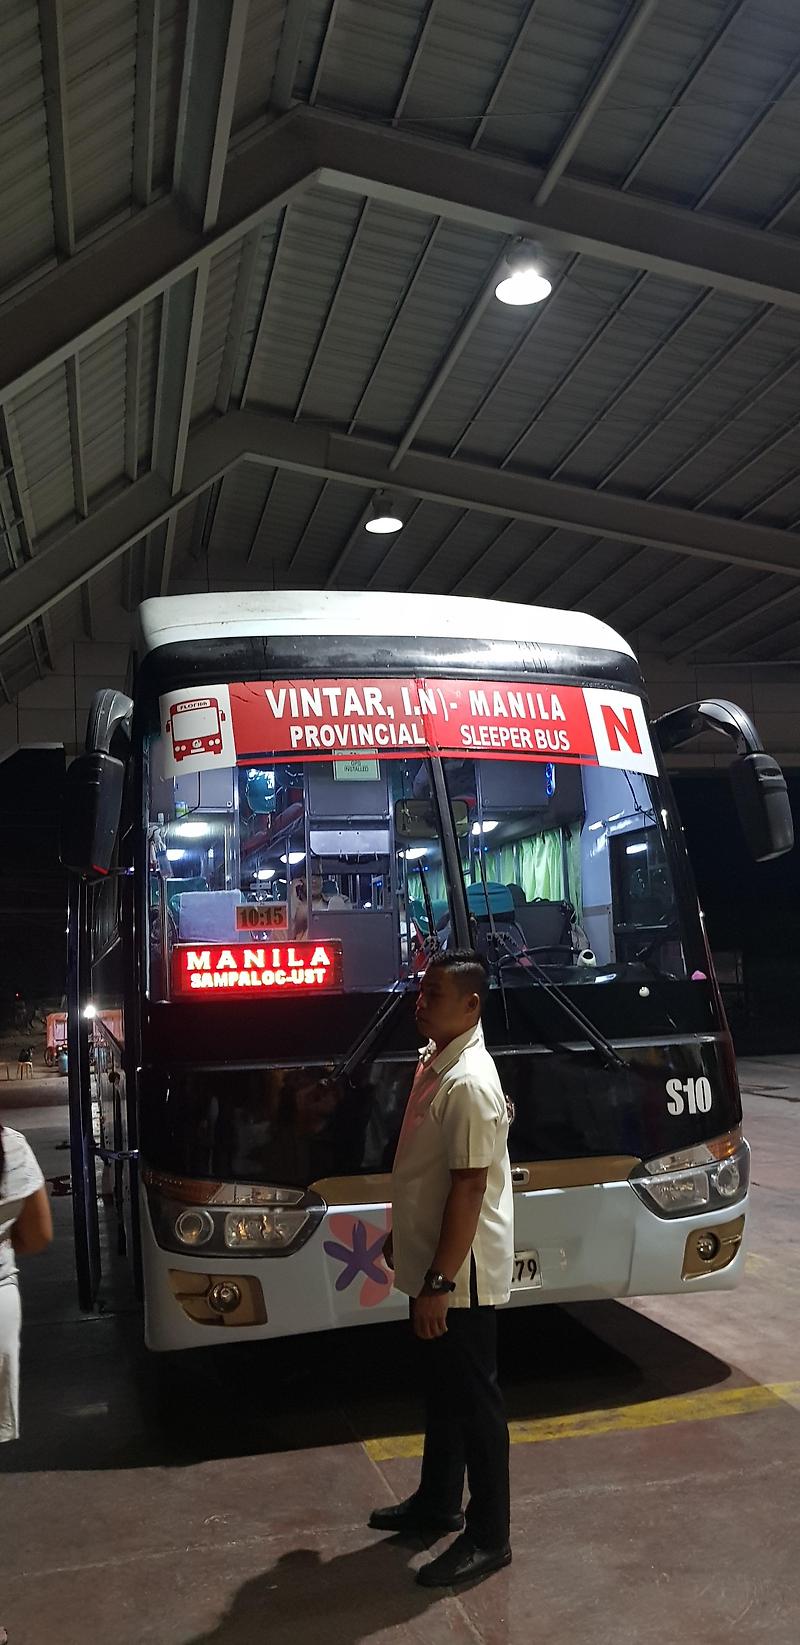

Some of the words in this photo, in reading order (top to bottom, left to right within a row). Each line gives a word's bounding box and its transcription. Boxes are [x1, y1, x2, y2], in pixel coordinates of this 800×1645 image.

[265, 687, 393, 720] VINTAR,
[469, 689, 566, 721] MANILA
[290, 723, 426, 748] PROVINCIAL
[460, 725, 533, 748] SLEEPER
[534, 728, 570, 751] BUS
[601, 705, 642, 754] N
[240, 909, 283, 927] 10:15
[186, 946, 330, 970] MANILA
[190, 968, 326, 988] SAMPALOC-UST
[666, 1077, 712, 1115] S10
